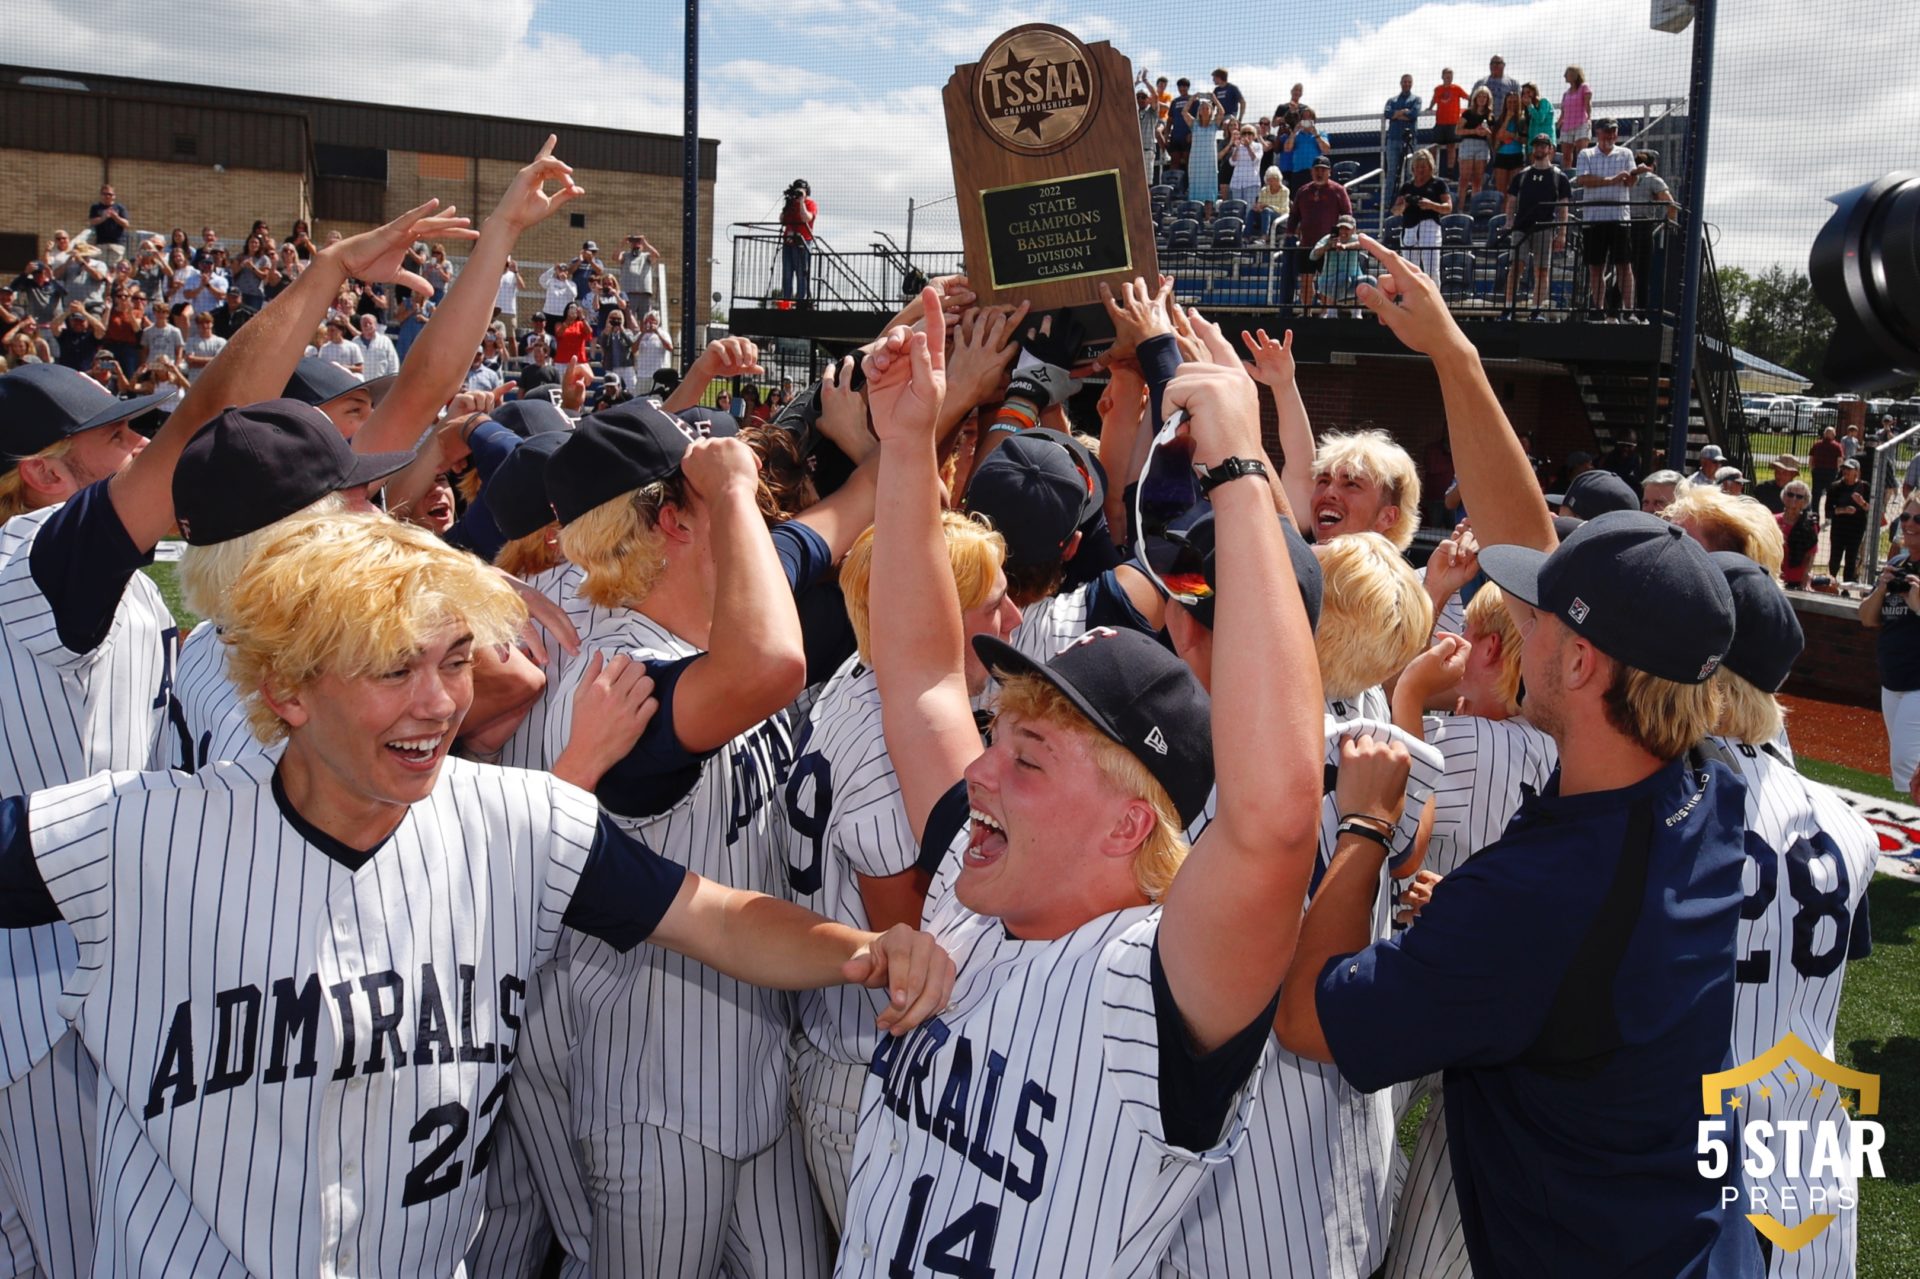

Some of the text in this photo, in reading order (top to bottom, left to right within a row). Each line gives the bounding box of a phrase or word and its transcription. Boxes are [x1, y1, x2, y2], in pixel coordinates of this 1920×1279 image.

[985, 60, 1086, 109] TSSAA
[1003, 99, 1073, 117] CHAMPIONSHIPS
[1039, 185, 1062, 198] 2022
[1028, 196, 1078, 216] STATE
[1008, 209, 1101, 236] CHAMPIONS
[1017, 228, 1097, 252] BASEBALL
[1027, 248, 1083, 265] DIVISION
[1037, 261, 1085, 277] CLASS 4A
[143, 962, 527, 1120] ADMIRALS
[888, 1174, 1000, 1279] 14
